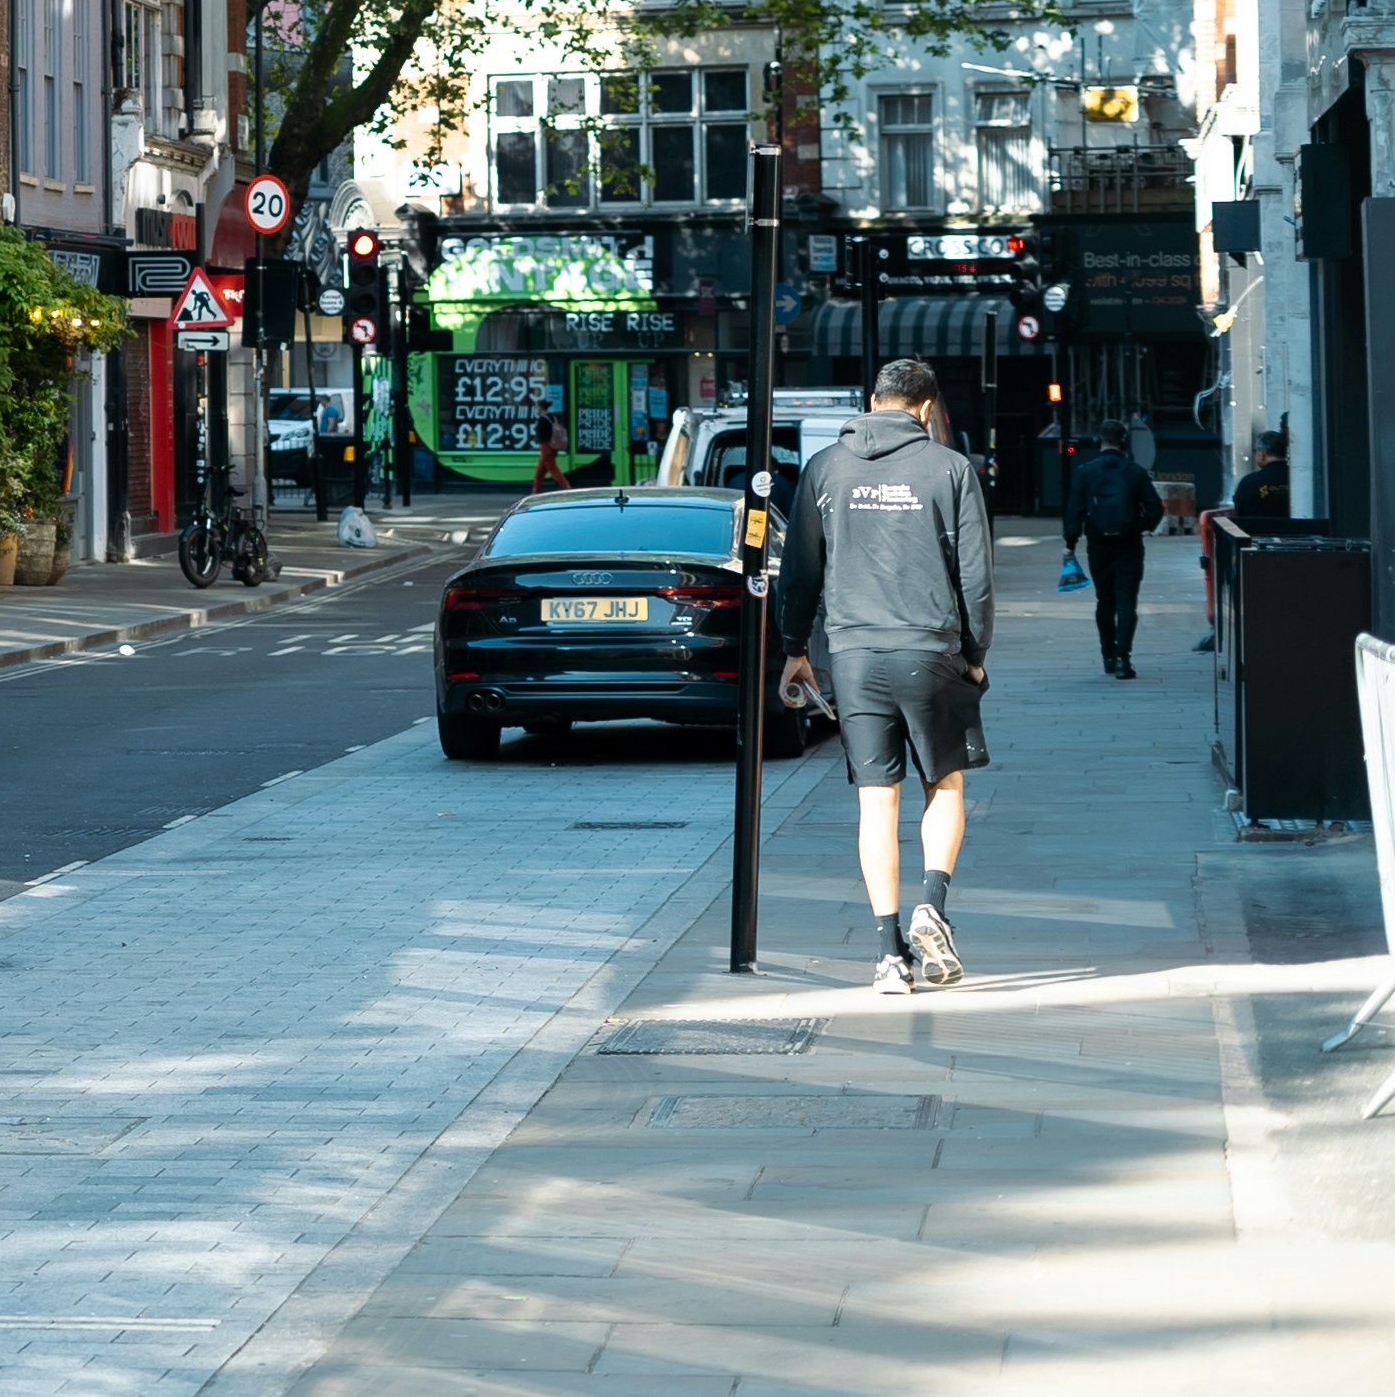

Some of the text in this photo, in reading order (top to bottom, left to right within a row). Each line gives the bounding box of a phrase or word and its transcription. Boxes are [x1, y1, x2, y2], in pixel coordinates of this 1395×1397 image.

[252, 192, 283, 217] 20
[1083, 252, 1191, 269] Best-in-class
[565, 313, 674, 332] RISE RISE
[455, 376, 546, 402] £12:95
[550, 602, 639, 619] KY67 JHJ
